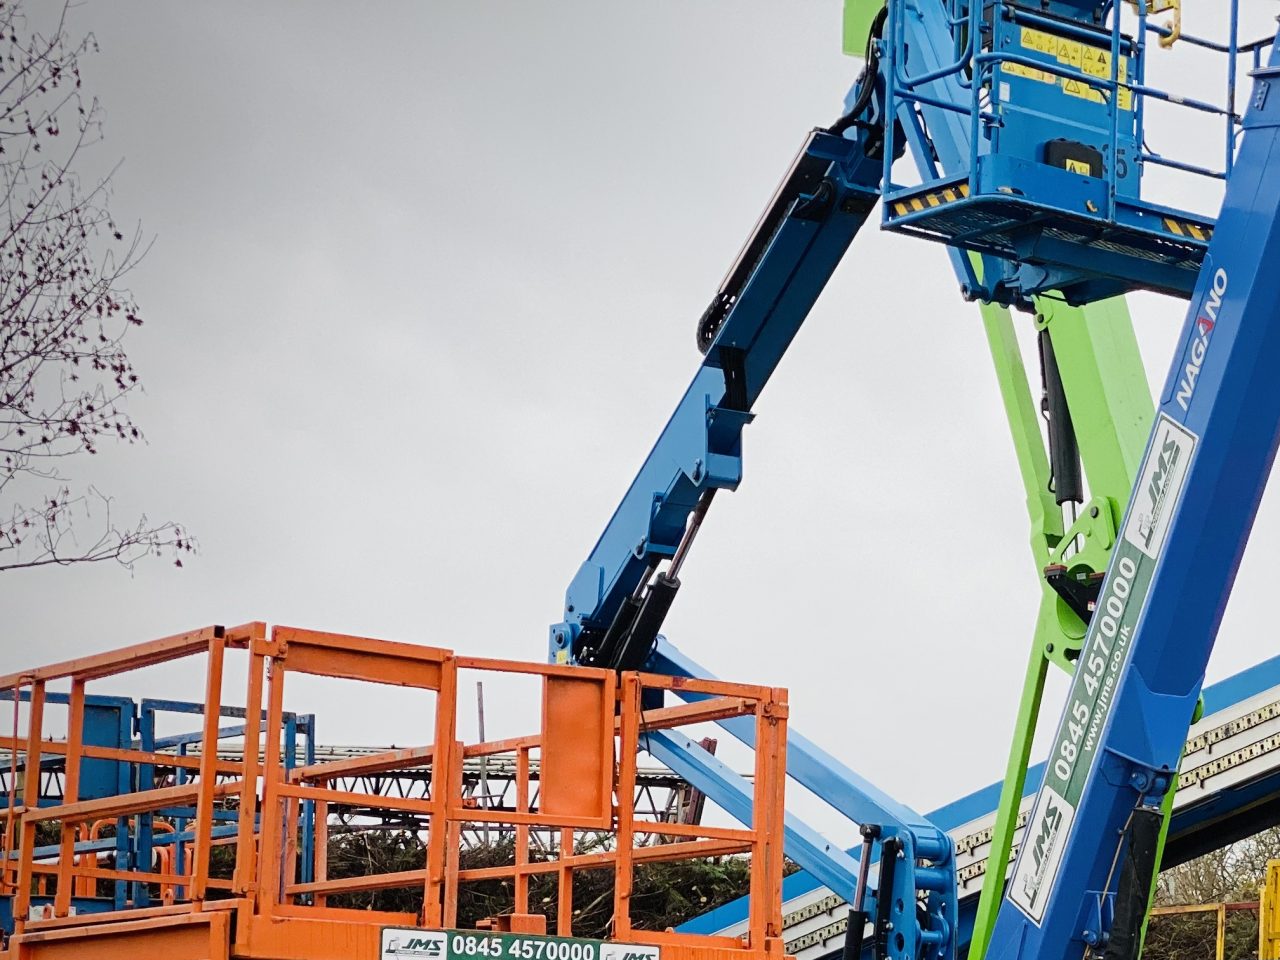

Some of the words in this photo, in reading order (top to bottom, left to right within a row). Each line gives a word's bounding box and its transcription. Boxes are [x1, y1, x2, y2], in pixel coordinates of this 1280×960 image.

[1176, 267, 1228, 412] NAGANO
[1148, 430, 1176, 516] JMS
[1054, 700, 1089, 782] 0845
[1083, 556, 1136, 698] 4570000
[1083, 623, 1131, 752] www.jms.co.uk
[1032, 795, 1058, 877] JMS
[401, 937, 444, 951] JMS
[452, 935, 502, 957] 0845
